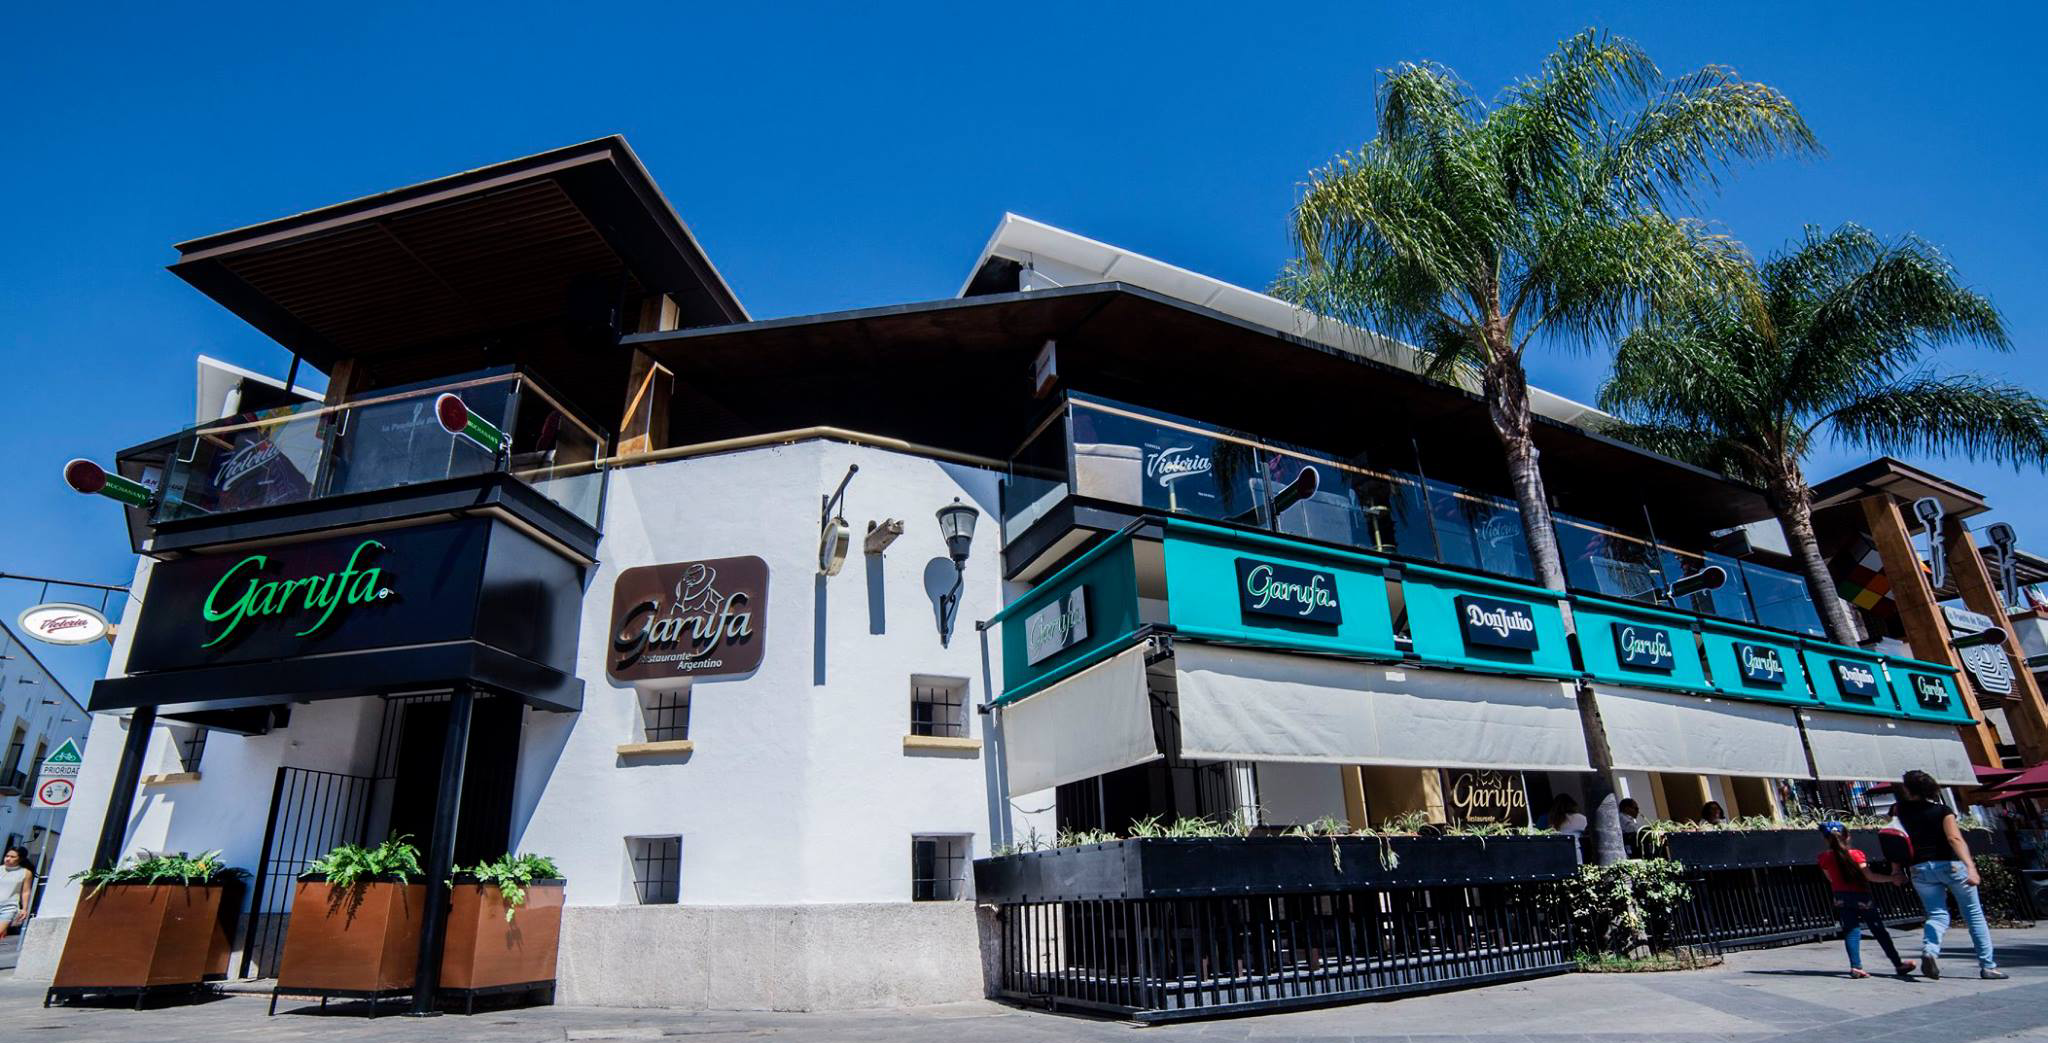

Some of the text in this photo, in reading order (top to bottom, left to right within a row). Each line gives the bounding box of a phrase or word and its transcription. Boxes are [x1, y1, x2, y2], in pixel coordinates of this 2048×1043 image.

[1147, 444, 1212, 488] Victoria
[201, 539, 387, 648] Garufa
[1247, 564, 1336, 615] Garufa
[40, 615, 88, 633] Victoria
[614, 592, 753, 662] Garufa
[641, 651, 691, 664] estaurante
[677, 658, 722, 672] Argentino
[1621, 626, 1672, 664] Garufa
[1742, 645, 1783, 679] Garufa
[1453, 772, 1526, 820] Garufa
